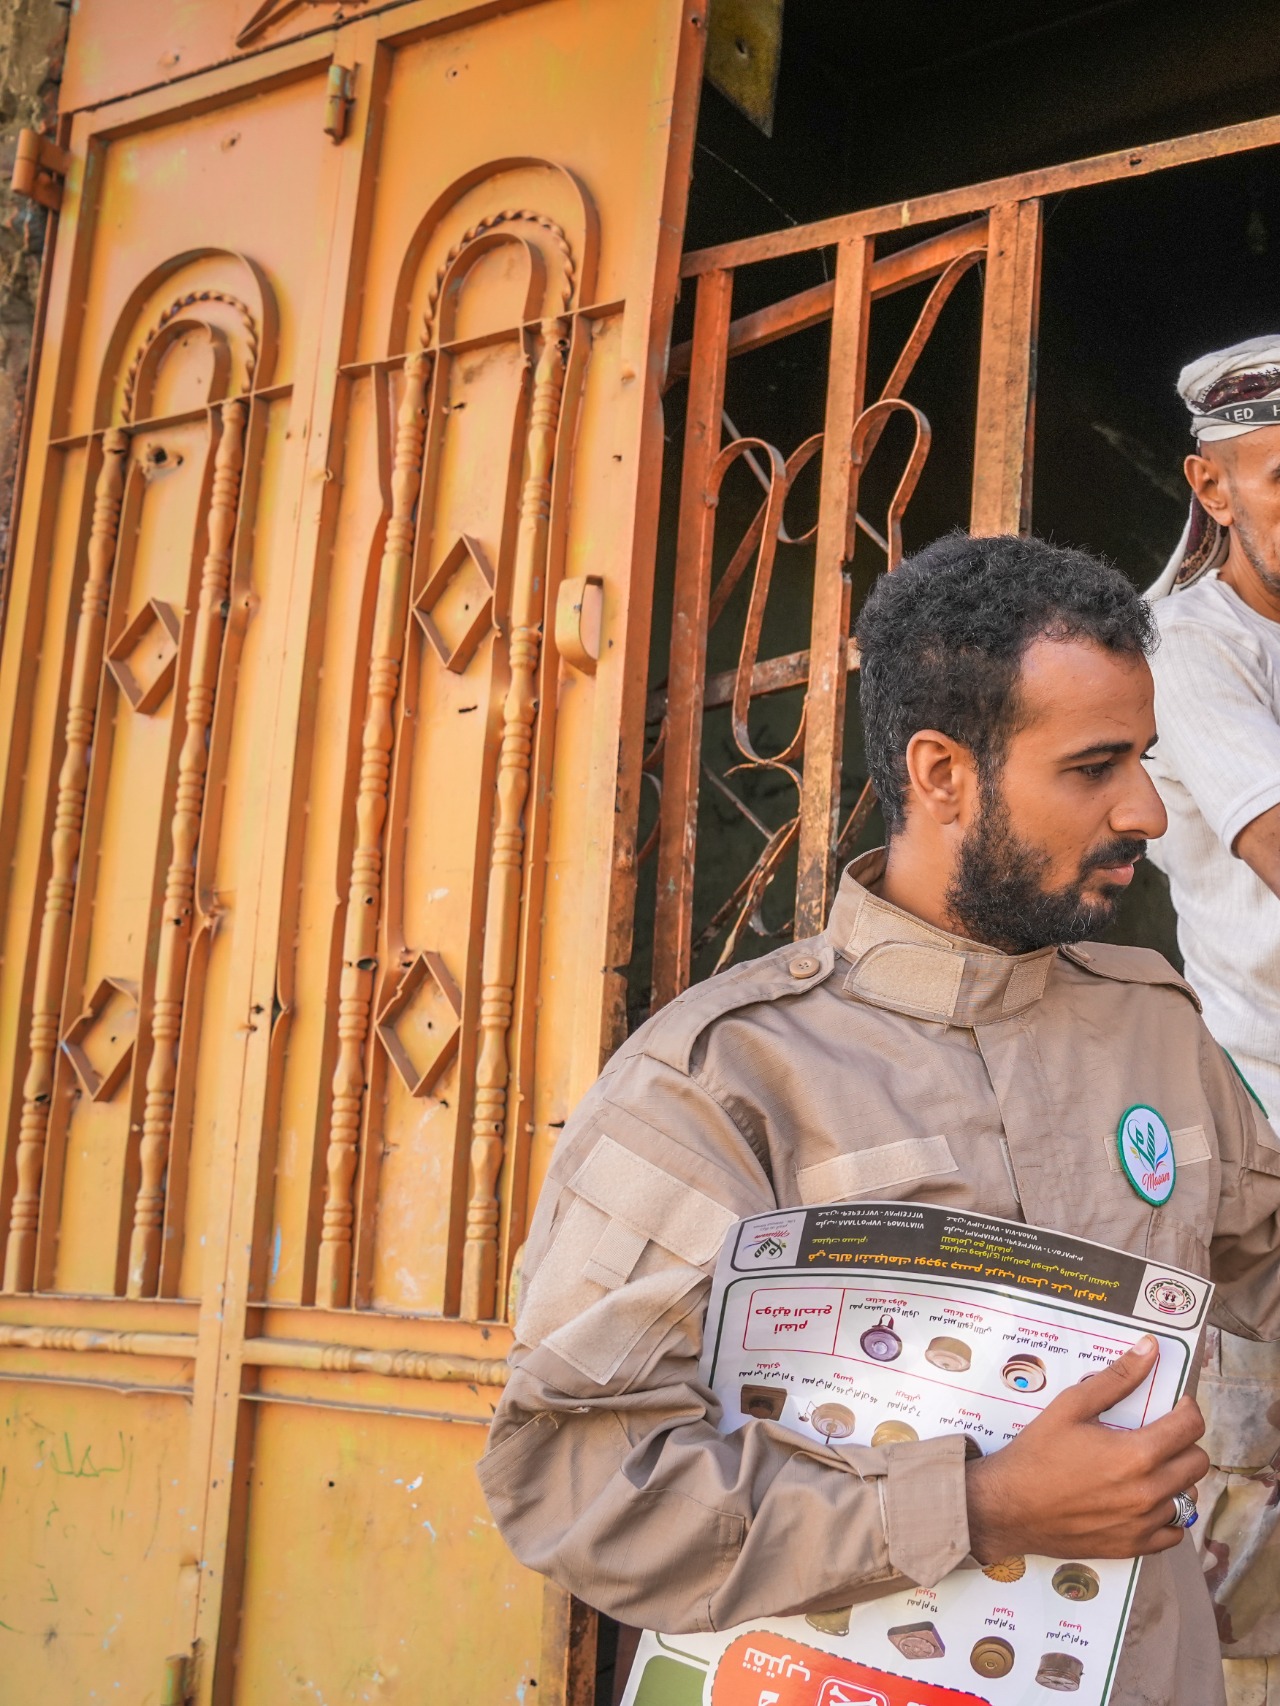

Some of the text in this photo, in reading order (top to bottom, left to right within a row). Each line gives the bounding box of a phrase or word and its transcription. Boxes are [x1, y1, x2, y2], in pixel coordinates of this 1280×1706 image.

[808, 1249, 1107, 1301] في حالة اشتباهك بوجود جسم غريب اتصل على الرقم:
[755, 1304, 832, 1317] حوثية الصنع
[774, 1320, 807, 1334] ألغام
[742, 1647, 811, 1682] تقترب
